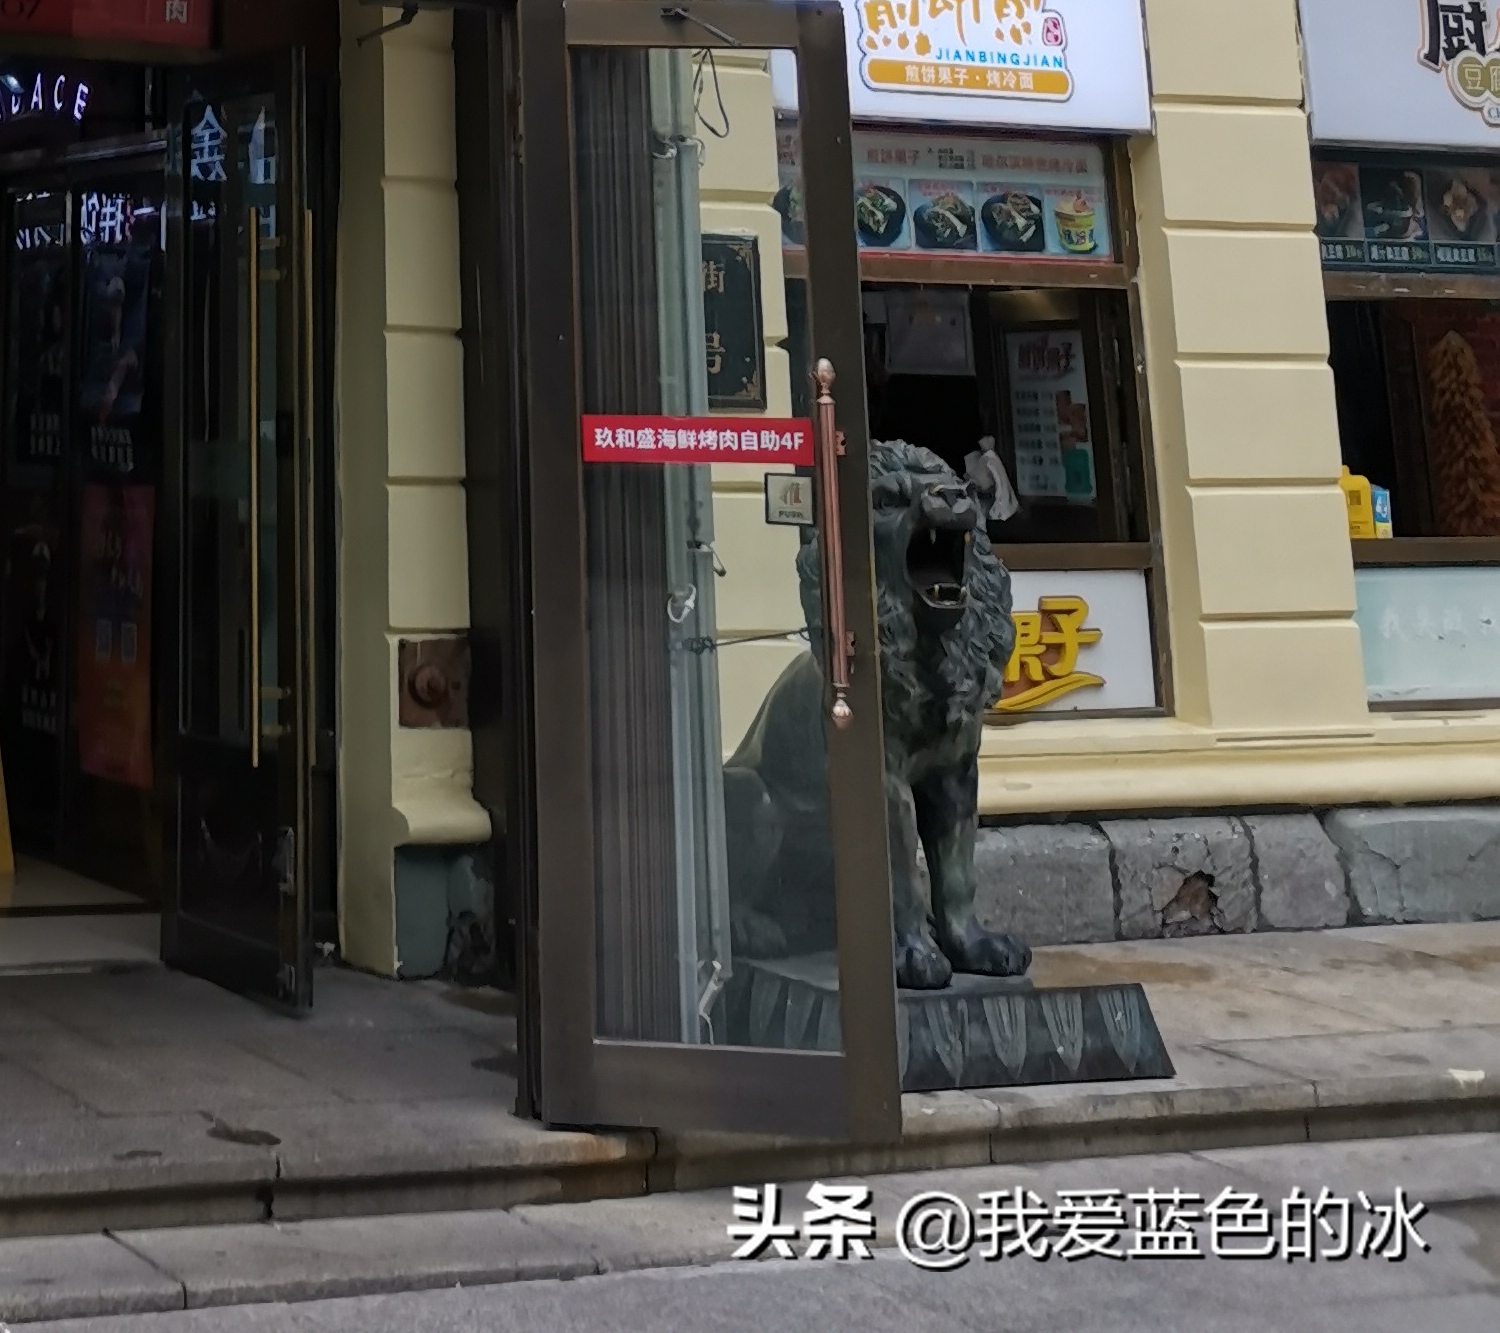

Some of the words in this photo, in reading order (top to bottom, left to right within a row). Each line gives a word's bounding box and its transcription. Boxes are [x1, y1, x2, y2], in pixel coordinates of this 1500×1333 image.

[934, 47, 1064, 69] JIANBINGJIAN
[594, 427, 805, 452] 玖和盛海鲜烤肉自助4F
